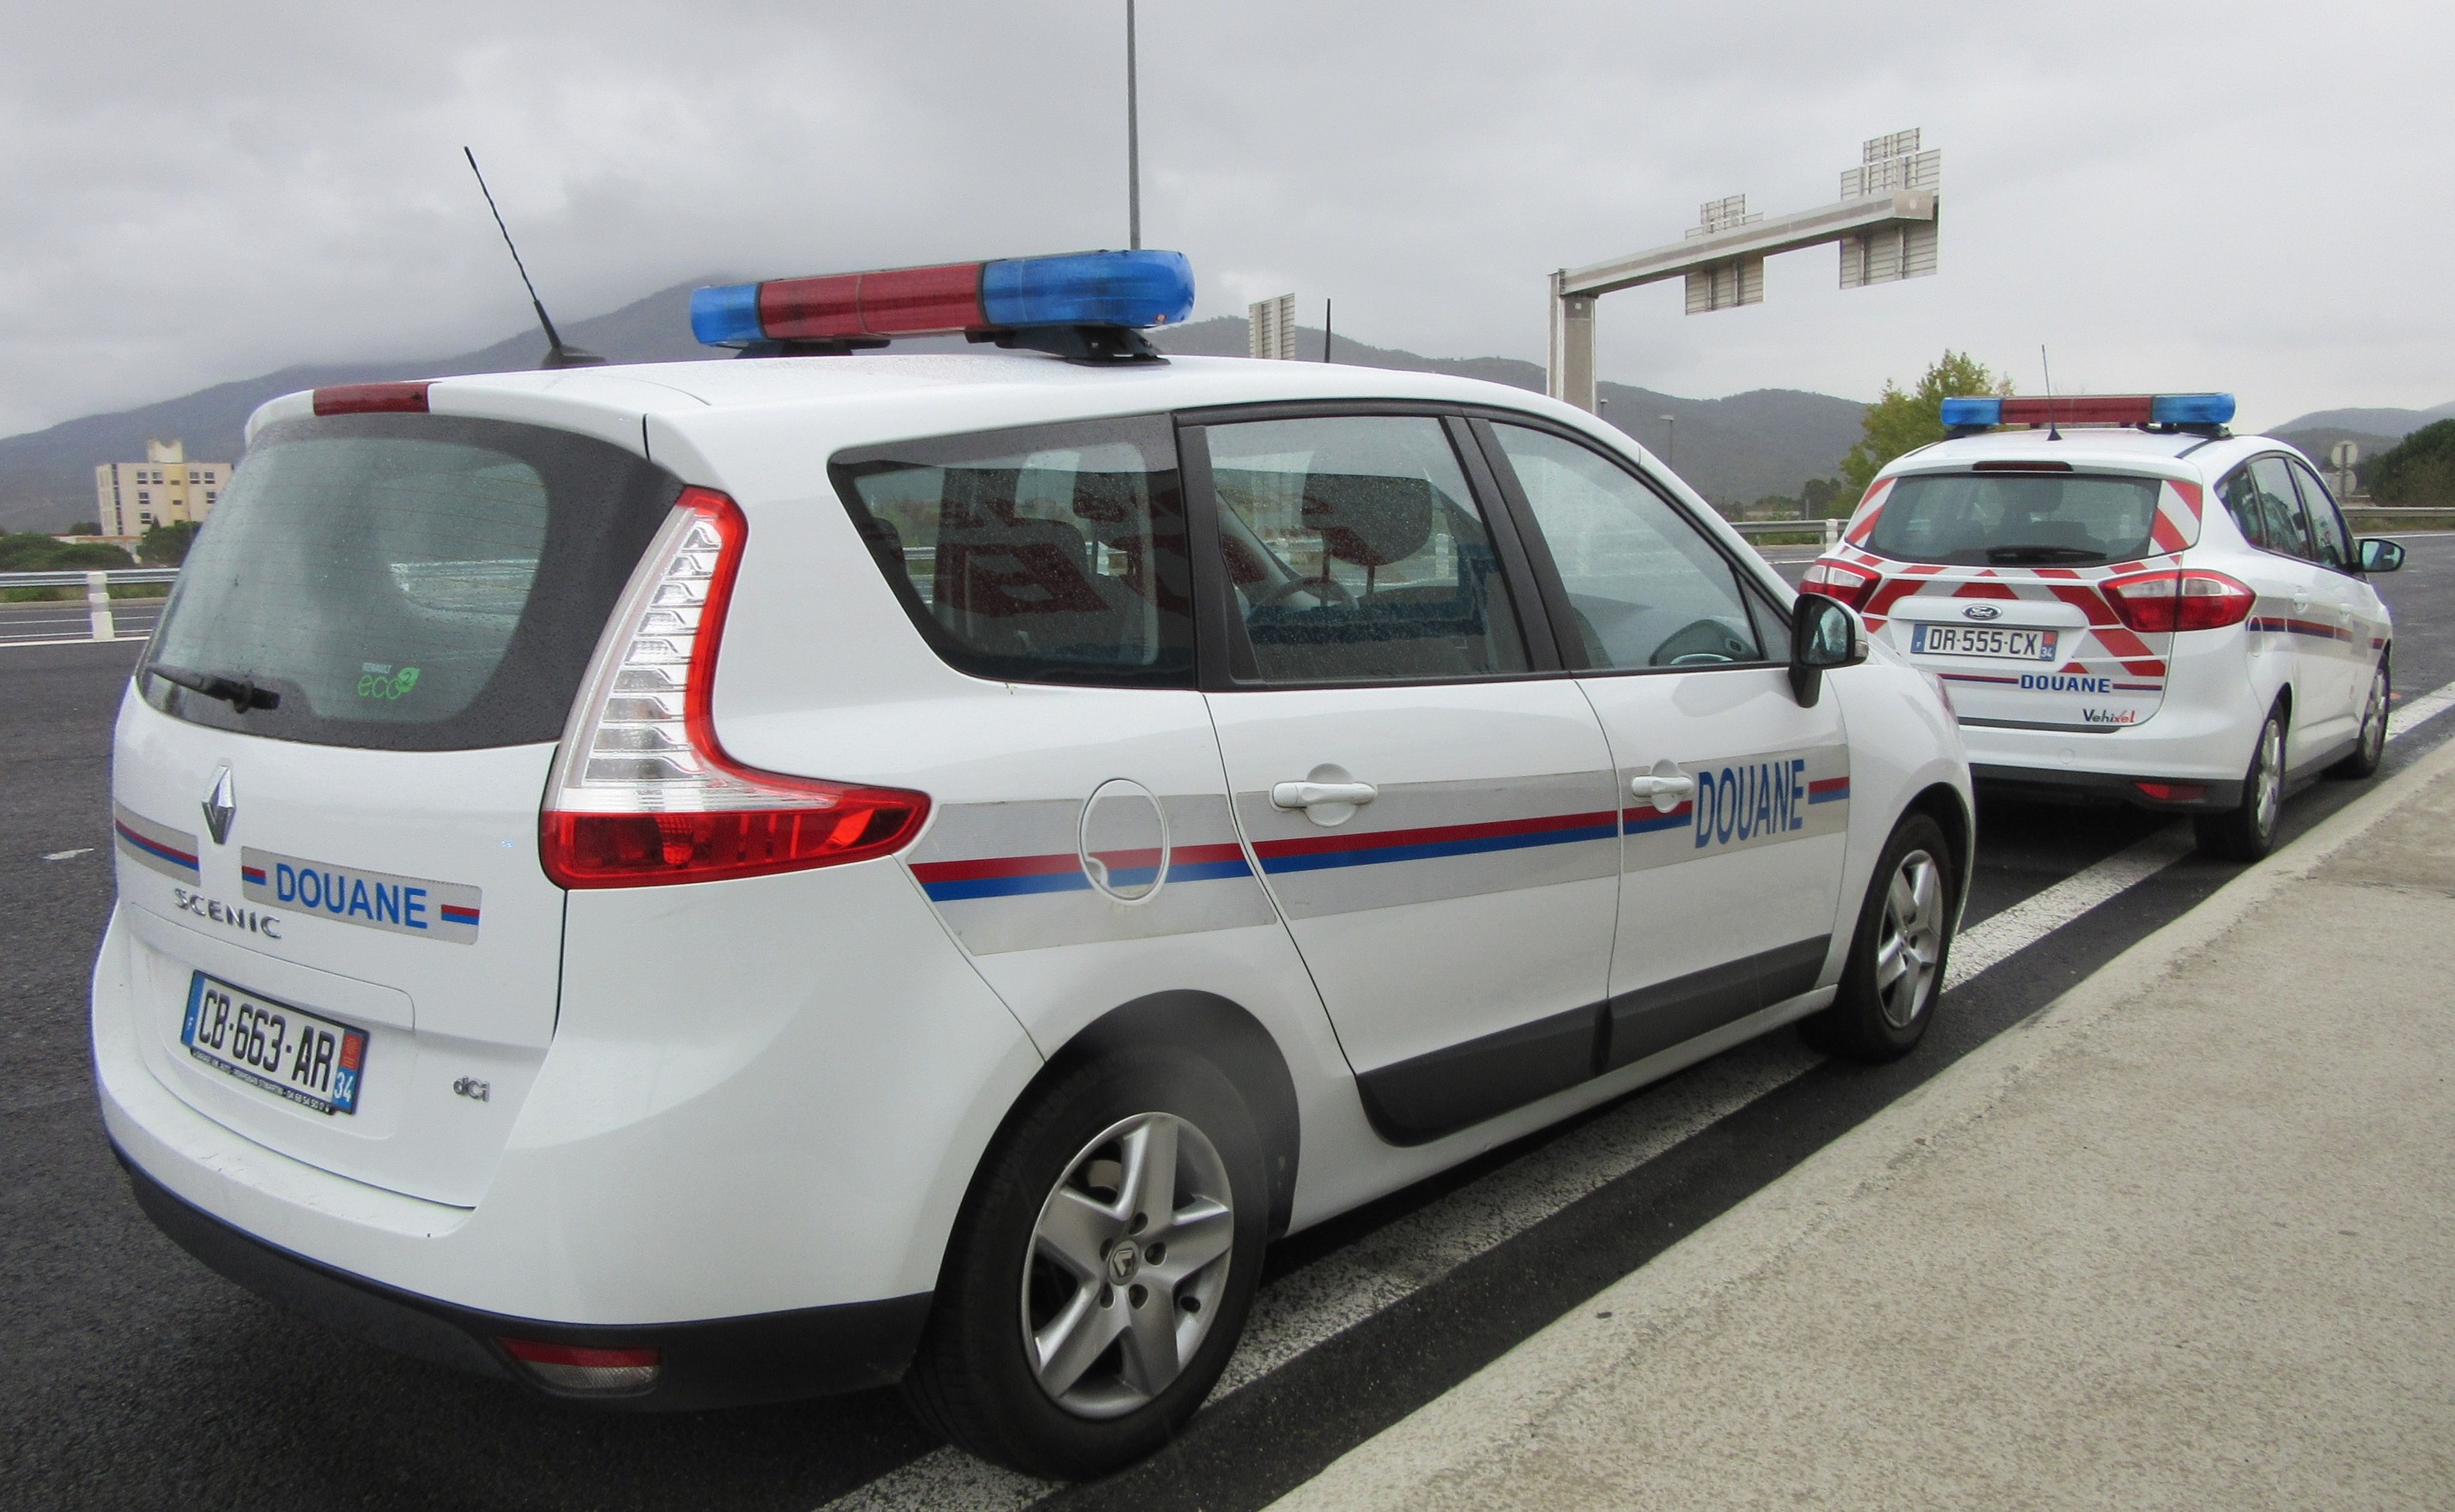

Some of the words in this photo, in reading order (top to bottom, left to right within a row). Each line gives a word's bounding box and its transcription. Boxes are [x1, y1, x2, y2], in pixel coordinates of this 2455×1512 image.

[1930, 629, 2038, 656] DR-555-CX
[2040, 647, 2052, 658] 34
[2021, 674, 2111, 693] DOUANE
[2082, 709, 2136, 723] Vehixel
[1695, 759, 1804, 849] DOUANE
[276, 862, 427, 929] DOUANE
[173, 887, 282, 940] SCENIC
[198, 989, 336, 1092] CB-663-AR
[333, 1071, 353, 1103] 34
[453, 1075, 490, 1103] dCi
